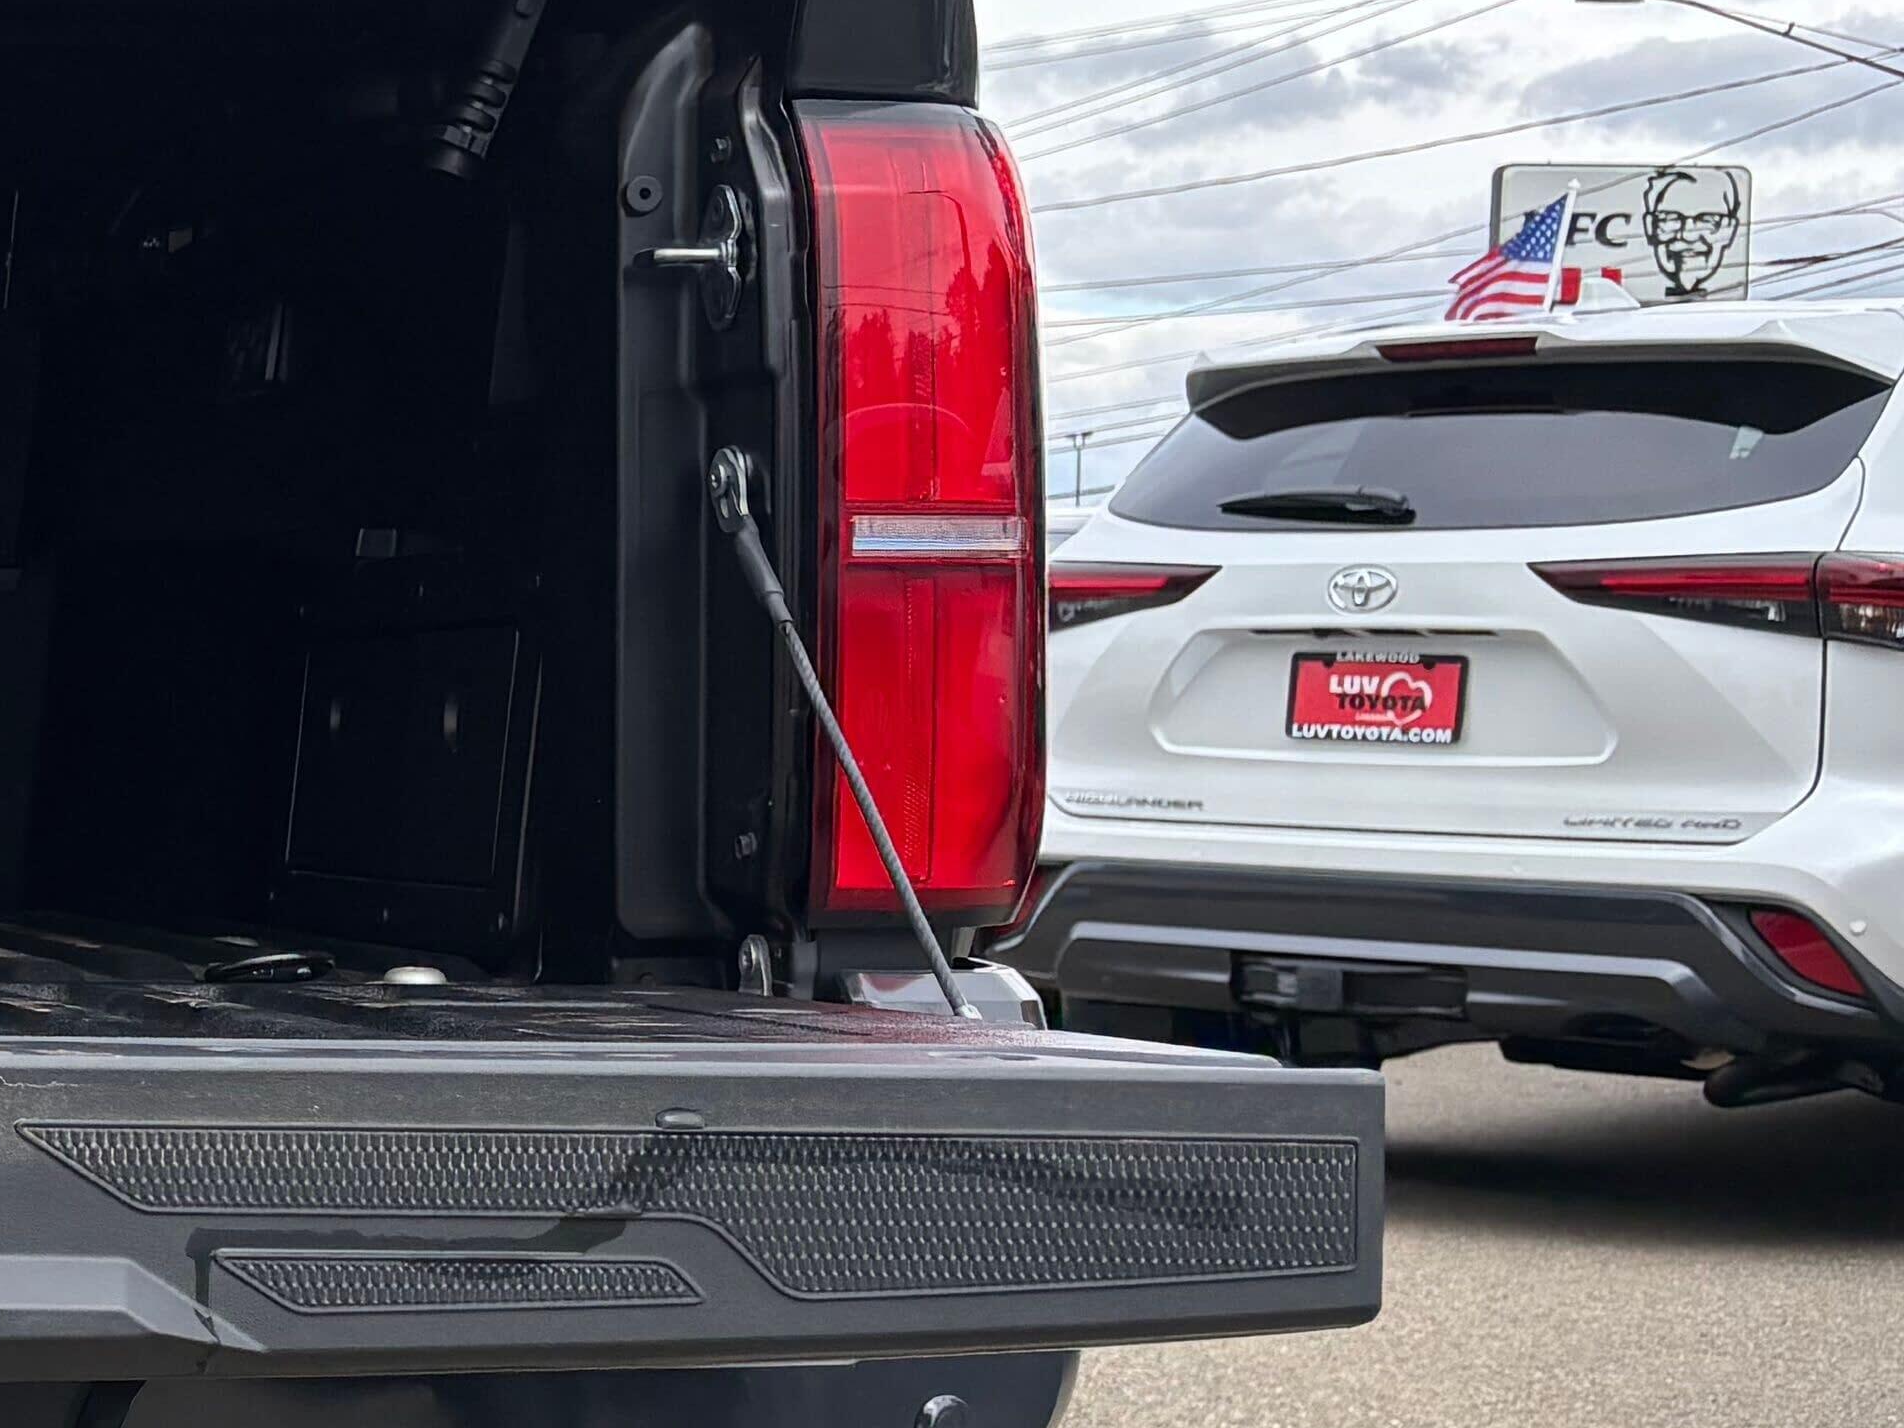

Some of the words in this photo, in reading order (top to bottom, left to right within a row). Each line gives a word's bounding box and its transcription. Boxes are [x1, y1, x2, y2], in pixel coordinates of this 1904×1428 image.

[1523, 210, 1632, 248] FC
[1329, 674, 1381, 694] LUV
[1336, 693, 1426, 712] TOYOTA
[1292, 723, 1452, 744] LUVTOYOTA.COM
